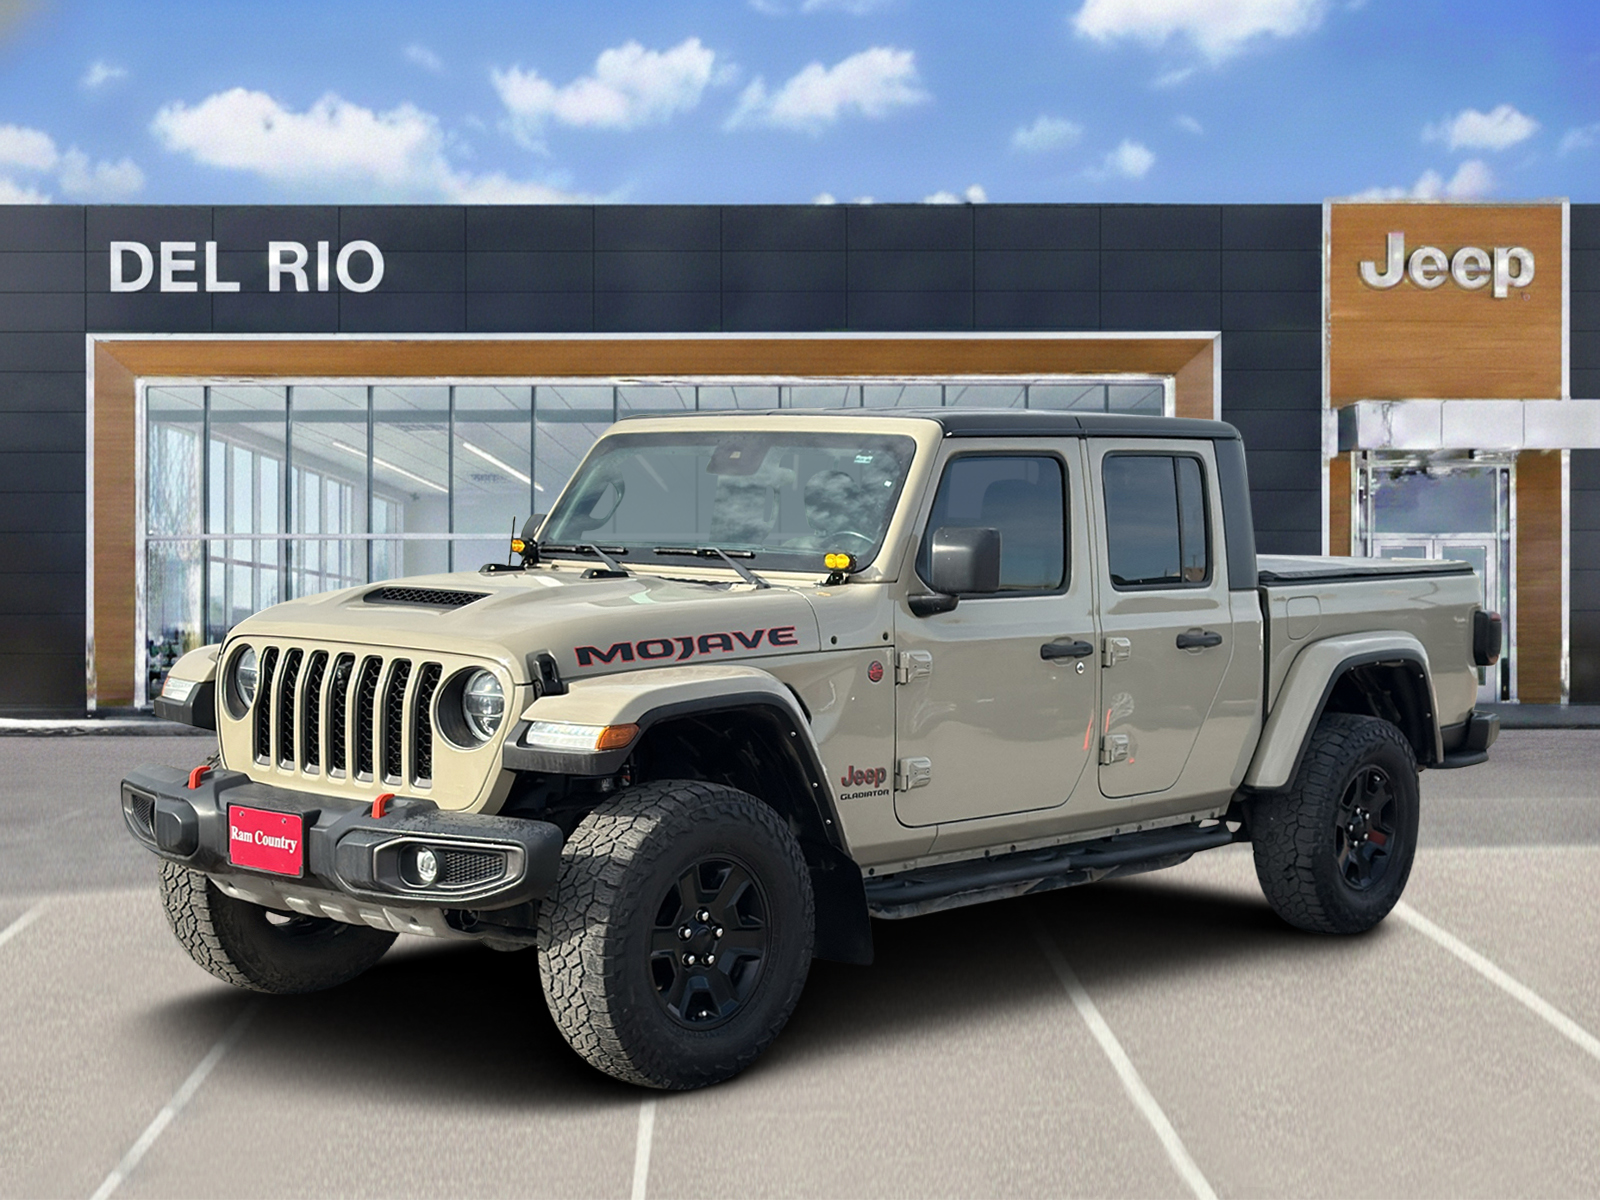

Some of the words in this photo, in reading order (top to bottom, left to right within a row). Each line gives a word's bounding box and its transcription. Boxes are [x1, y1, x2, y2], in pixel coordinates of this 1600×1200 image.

[110, 241, 240, 292] DEL
[268, 240, 385, 293] RIO
[1359, 231, 1535, 298] Jeep
[574, 626, 798, 667] MOJAVE
[841, 765, 887, 788] Jeep
[840, 789, 889, 800] GLADIATOR
[231, 825, 253, 843] Ram
[254, 830, 297, 854] Country
